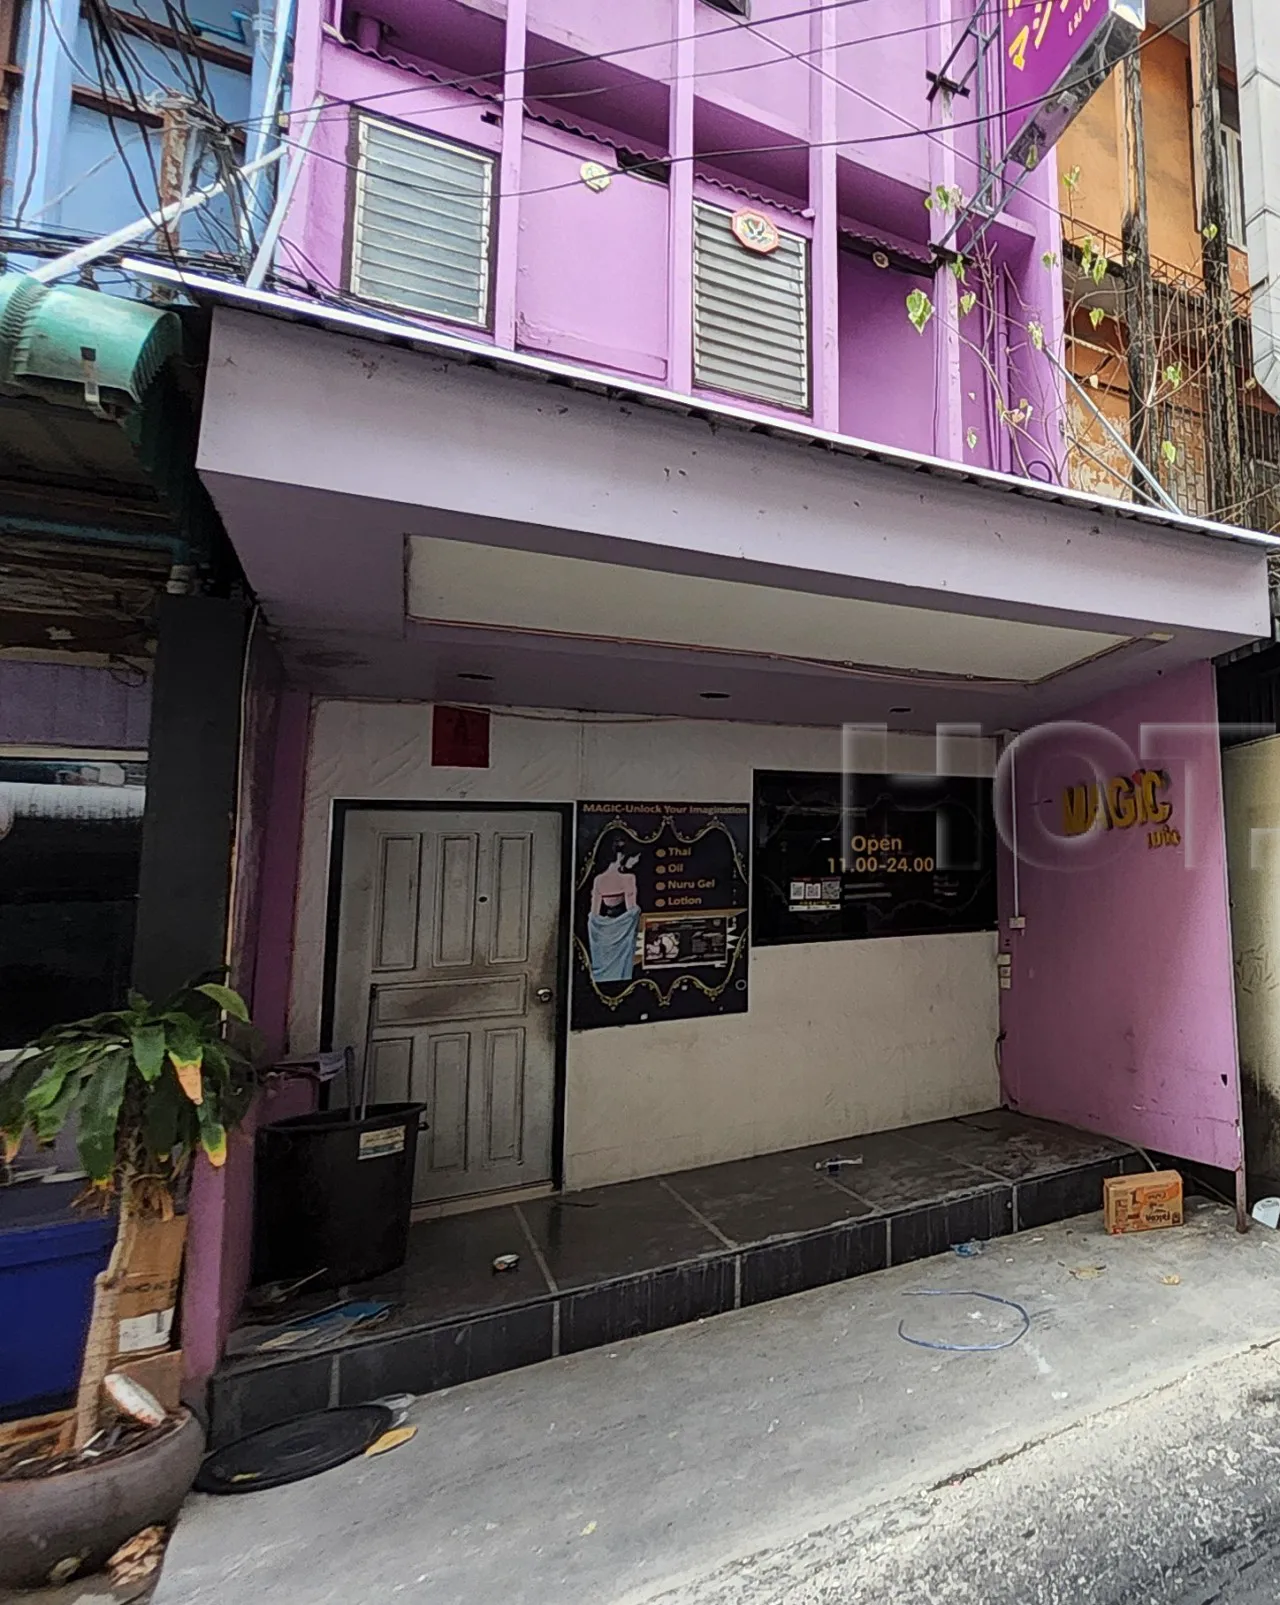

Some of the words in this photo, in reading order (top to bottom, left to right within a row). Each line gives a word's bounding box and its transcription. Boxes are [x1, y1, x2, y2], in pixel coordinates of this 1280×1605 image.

[664, 805, 688, 815] Your
[689, 805, 748, 816] Imagination
[851, 835, 902, 854] Open
[668, 847, 692, 857] Thai
[668, 863, 684, 873] Oil
[828, 857, 934, 873] 11.00-24.00
[668, 880, 695, 890] Nuru
[698, 879, 715, 889] Gel
[668, 896, 702, 906] Lotion
